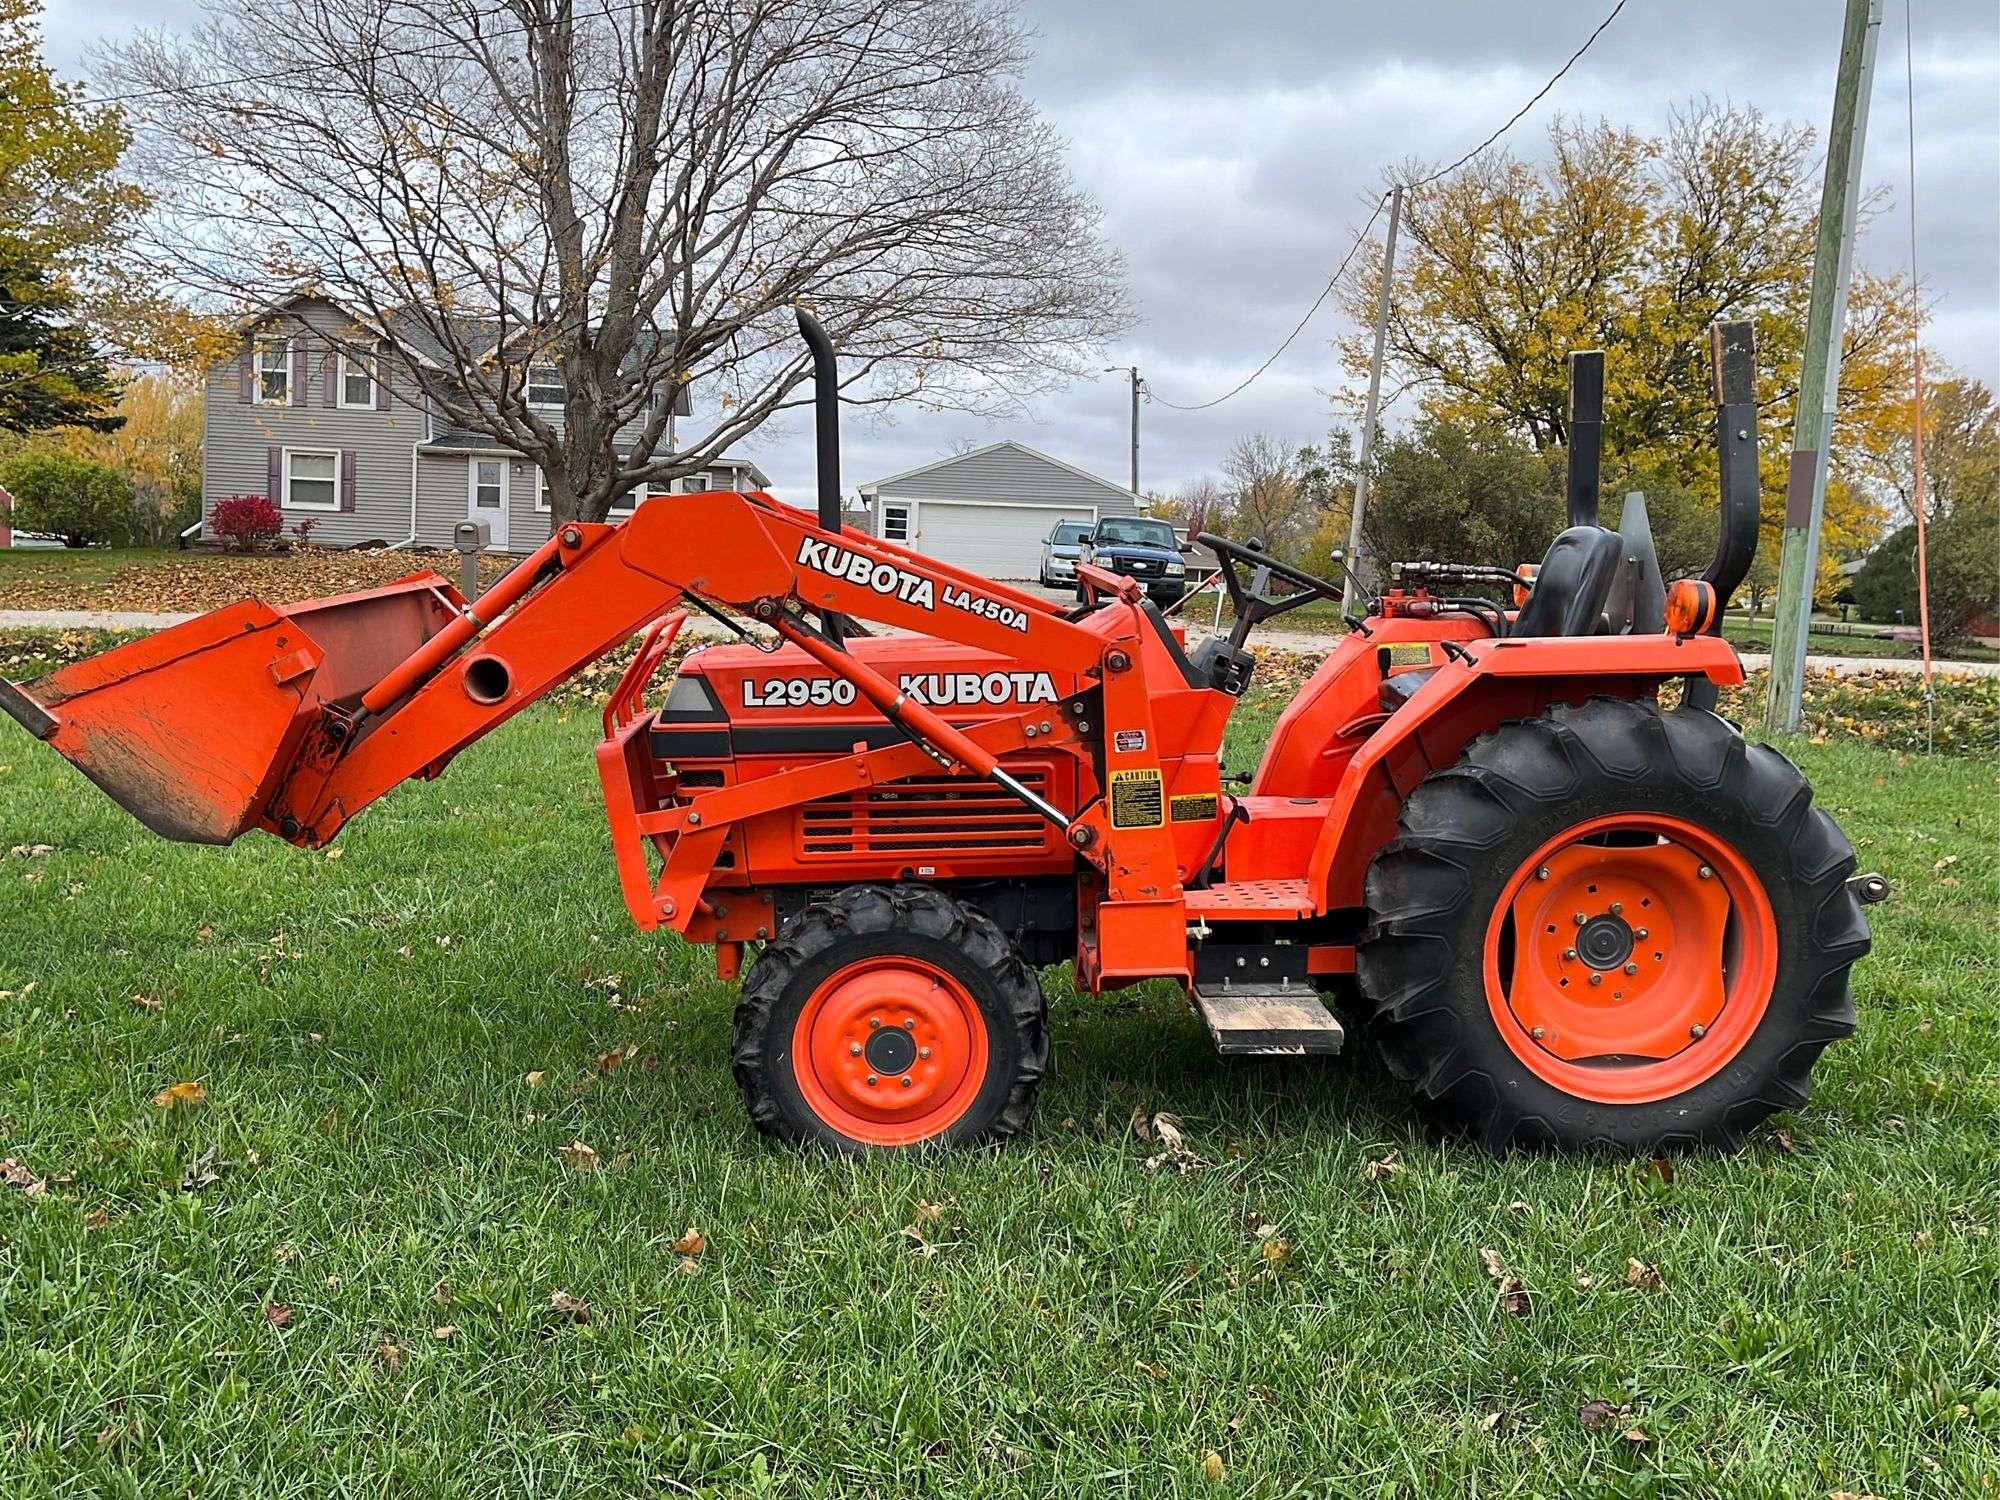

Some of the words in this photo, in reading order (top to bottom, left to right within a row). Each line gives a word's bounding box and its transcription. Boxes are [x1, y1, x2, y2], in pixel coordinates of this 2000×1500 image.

[798, 537, 933, 610] KUBOTA
[942, 585, 1027, 632] LA450A
[744, 679, 856, 706] L2950
[897, 673, 1058, 705] KUBOTA
[1124, 771, 1158, 781] CAUTION
